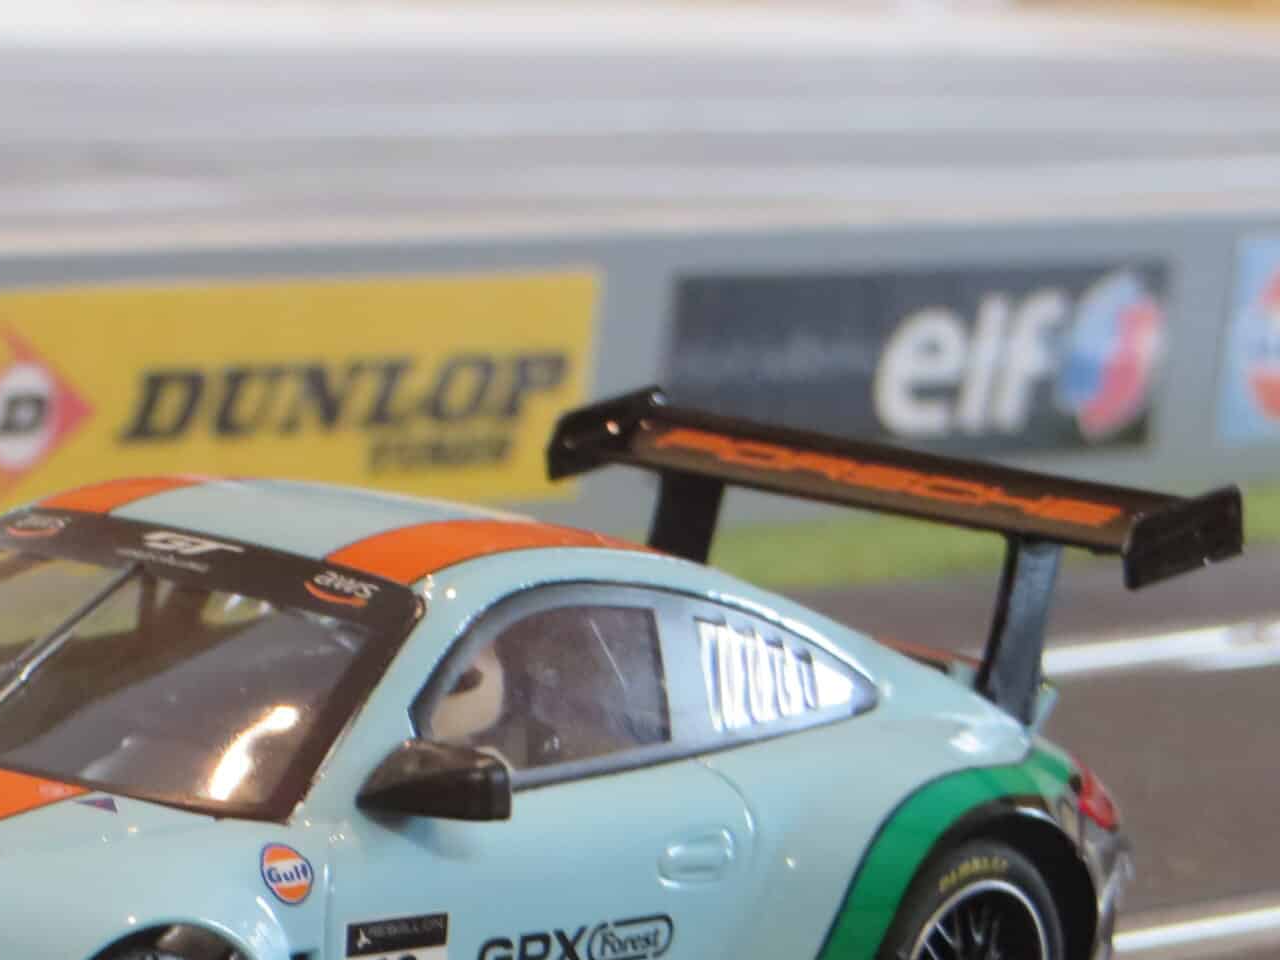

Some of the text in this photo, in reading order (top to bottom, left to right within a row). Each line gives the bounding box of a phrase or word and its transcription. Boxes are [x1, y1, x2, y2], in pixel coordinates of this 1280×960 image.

[872, 291, 1067, 440] elf
[116, 350, 568, 445] DUNLOP
[266, 864, 310, 886] Gulf
[599, 927, 662, 959] Forest
